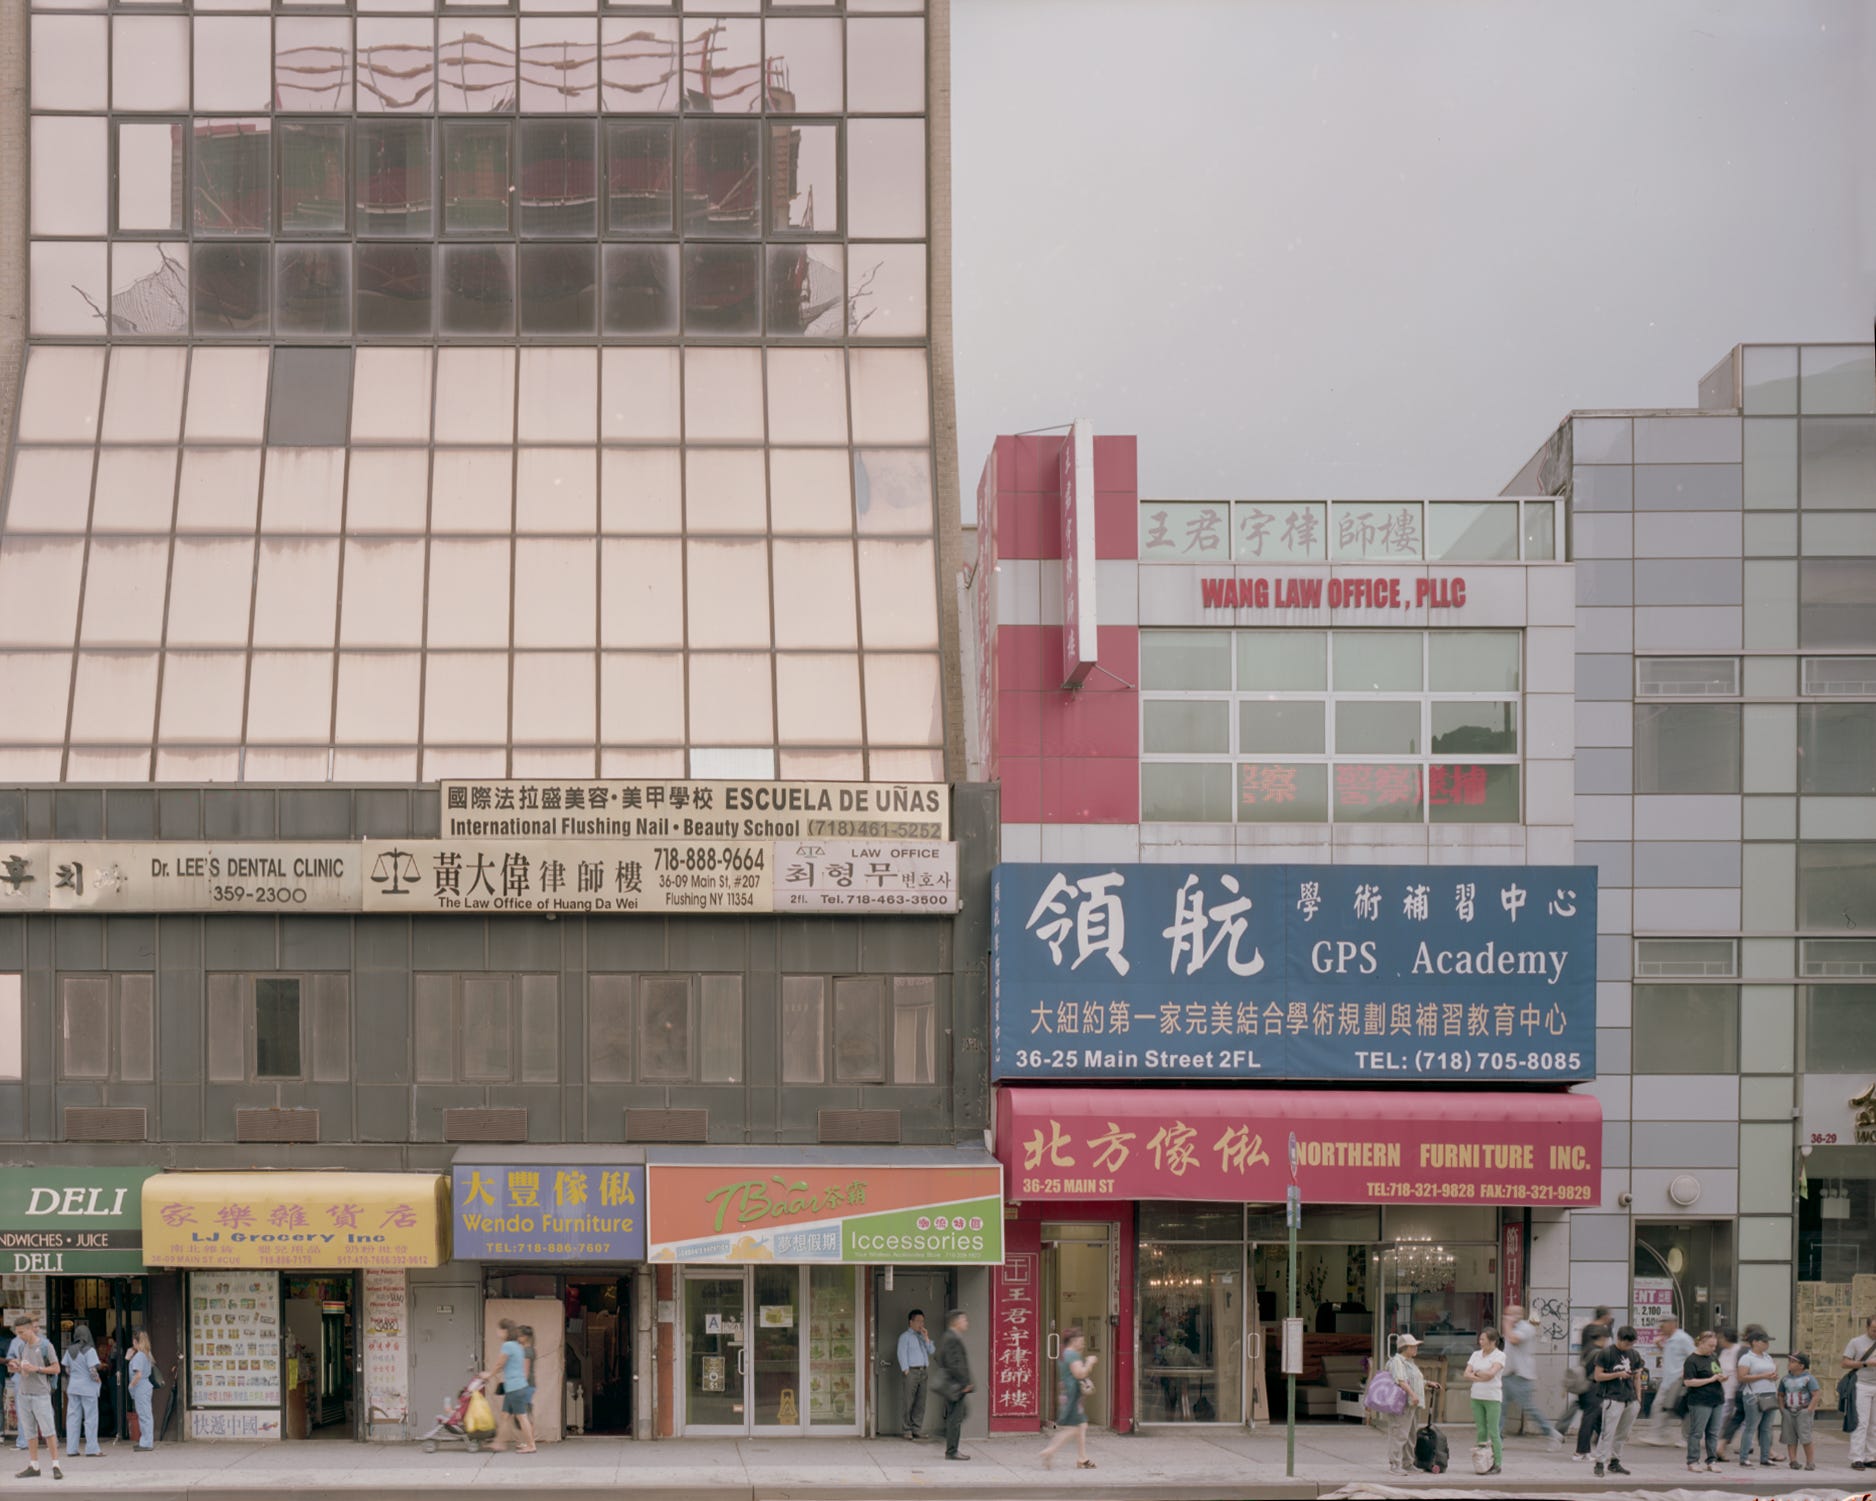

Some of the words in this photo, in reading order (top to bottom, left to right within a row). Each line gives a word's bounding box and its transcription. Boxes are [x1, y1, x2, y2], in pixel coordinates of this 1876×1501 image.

[1146, 506, 1420, 556] 王君宇律師樓
[1201, 577, 1269, 608] WANG
[1274, 577, 1322, 608] LAW
[1416, 577, 1466, 608] PLLC
[725, 787, 832, 811] ESCUELA
[839, 789, 868, 811] DE
[876, 786, 940, 812] UÑAS
[450, 818, 556, 836] International
[562, 818, 630, 838] Flushing
[636, 818, 669, 836] Nail
[683, 819, 739, 839] Beauty
[743, 819, 799, 837] School
[807, 820, 942, 839] (718)461-5252
[654, 847, 765, 871] 718-888-9664
[851, 849, 881, 858] LAW
[890, 849, 940, 858] OFFICE
[151, 858, 170, 878] Dr.
[177, 858, 219, 878] LEE'S
[227, 858, 286, 878] DENTAL
[293, 858, 344, 878] CLINIC
[433, 852, 643, 896] 黃大偉律師樓
[659, 875, 688, 888] 36-09
[691, 875, 716, 888] Main
[734, 875, 760, 889] #207
[213, 886, 307, 904] 359-2300
[438, 897, 461, 909] The
[464, 897, 490, 909] Law
[494, 897, 532, 909] Office
[537, 897, 550, 909] of
[553, 898, 592, 911] Huang
[595, 898, 611, 909] Da
[616, 898, 638, 909] Wei
[665, 892, 707, 908] Flushing
[709, 893, 724, 906] NY
[727, 893, 754, 906] 11354
[1297, 881, 1577, 923] 學術補習中心
[1025, 872, 1264, 976] 領航
[1311, 940, 1377, 974] GPS
[1411, 941, 1568, 984] Academy
[1016, 1050, 1078, 1068] 36-25
[1084, 1050, 1138, 1068] Main
[1145, 1050, 1214, 1068] Street
[1219, 1050, 1261, 1068] 2FL
[1355, 1051, 1408, 1070] TEL:
[1415, 1050, 1472, 1072] (718)
[1477, 1052, 1581, 1070] 705-8085
[1296, 1141, 1400, 1168] NORTHERN
[1419, 1143, 1534, 1169] FURNITURE
[1549, 1145, 1591, 1170] INC.
[1023, 1178, 1061, 1193] 36-25
[1063, 1179, 1096, 1193] MAIN
[1099, 1179, 1114, 1193] ST
[25, 1187, 128, 1216] DELI
[463, 1213, 535, 1232] Wendo
[542, 1213, 633, 1232] Furniture
[76, 1233, 108, 1247] JUICE
[191, 1232, 220, 1242] LJ
[231, 1232, 335, 1243] Grocery
[347, 1232, 386, 1243] Inc
[13, 1253, 64, 1272] DELI
[708, 1316, 719, 1328] A
[1000, 1287, 1032, 1407] 王君宇律師樓
